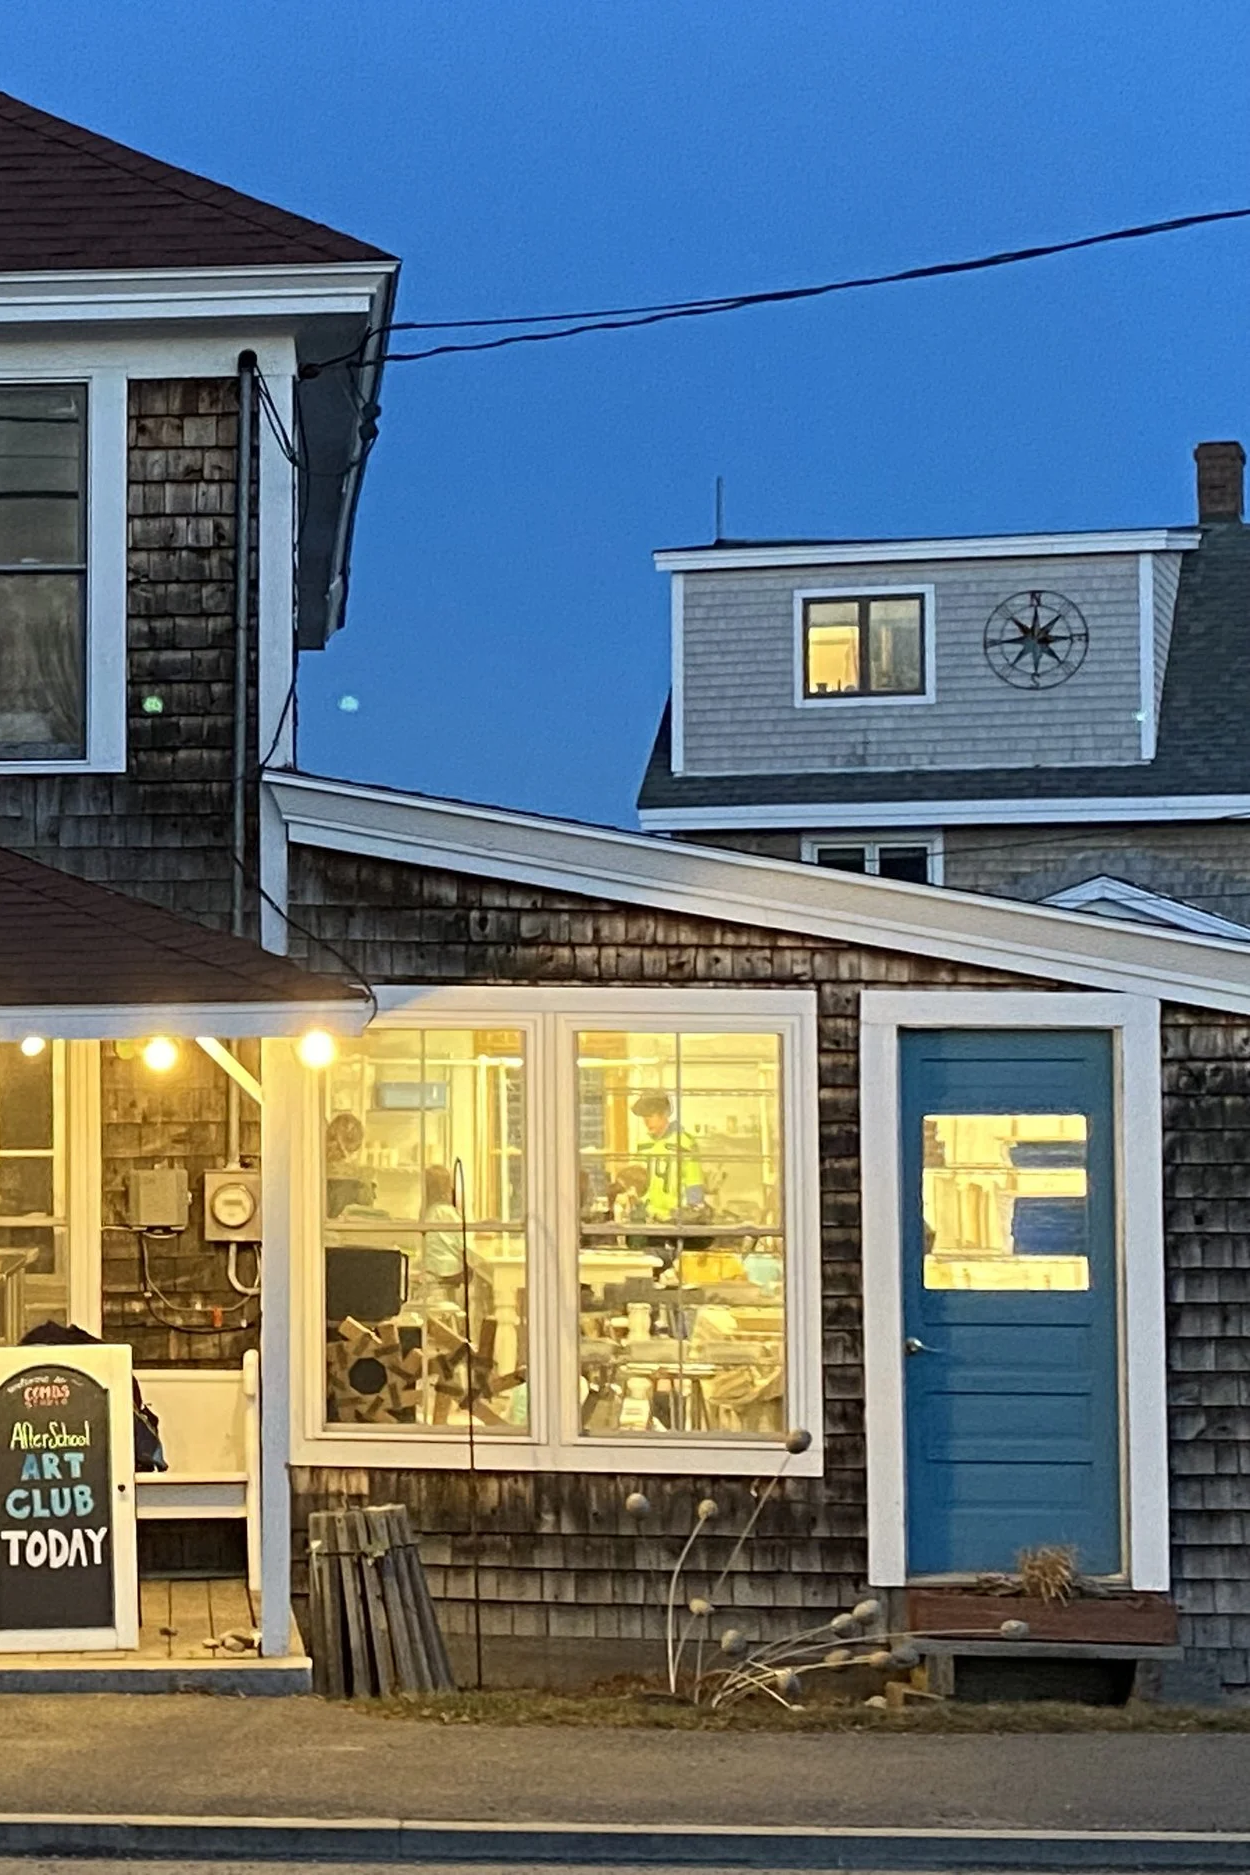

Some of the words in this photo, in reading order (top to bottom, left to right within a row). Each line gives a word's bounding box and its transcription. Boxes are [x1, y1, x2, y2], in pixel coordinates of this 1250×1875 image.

[21, 1452, 85, 1481] ART
[5, 1484, 95, 1519] CLUB
[0, 1526, 108, 1569] TODAY
